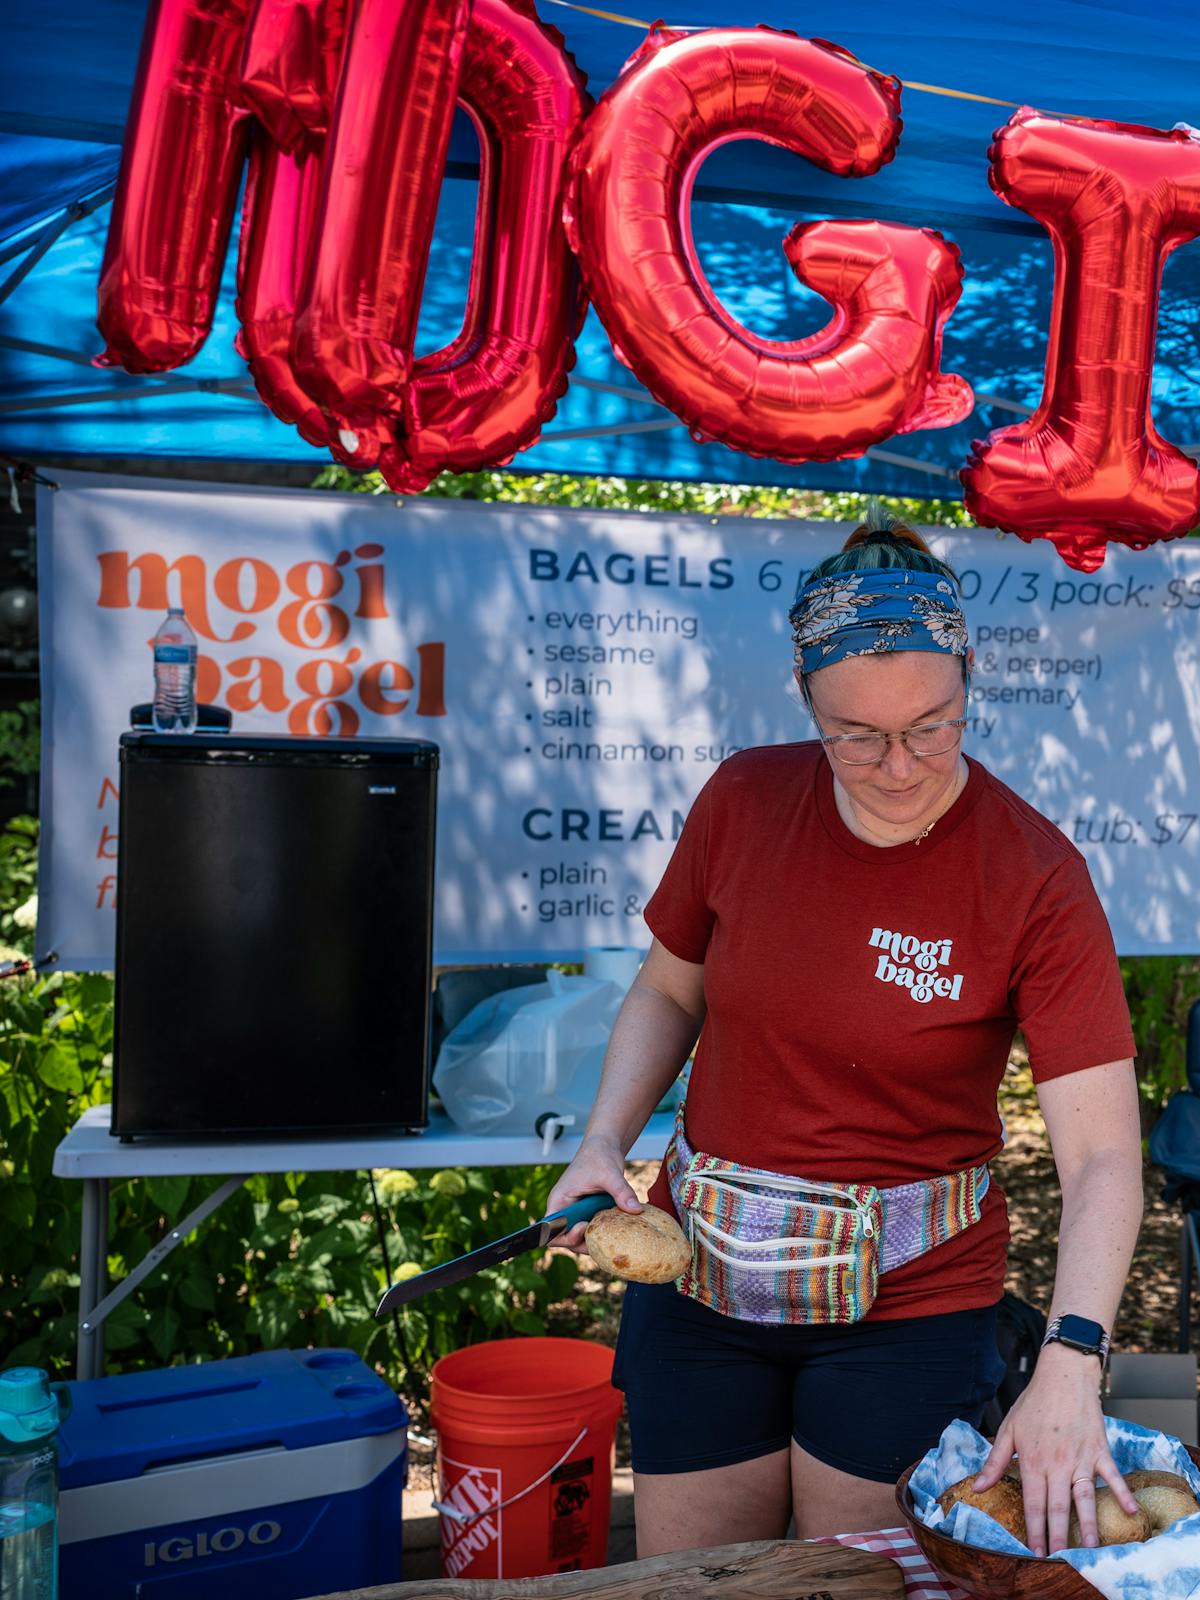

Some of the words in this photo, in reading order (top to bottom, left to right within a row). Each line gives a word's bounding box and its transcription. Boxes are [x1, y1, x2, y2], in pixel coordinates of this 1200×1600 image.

[529, 548, 735, 590] BAGELS
[758, 560, 783, 592] 6
[1015, 571, 1040, 603] 3
[1050, 575, 1154, 611] pack:
[97, 543, 390, 651] mogi
[544, 608, 699, 640] everything
[976, 624, 1041, 647] pepe
[544, 642, 655, 664] sesame
[982, 652, 999, 673] &
[1006, 654, 1103, 680] pepper)
[544, 672, 612, 699] plain
[971, 686, 1081, 711] osemary
[542, 705, 593, 728] salt
[541, 738, 684, 762] cinnamon
[1073, 813, 1142, 844] tub:
[1150, 809, 1199, 848] $7
[539, 862, 607, 890] plain
[538, 895, 614, 922] garlic
[623, 896, 642, 917] &
[868, 927, 953, 971] mogi
[874, 955, 964, 1003] bagel
[144, 1520, 282, 1567] IGLOO
